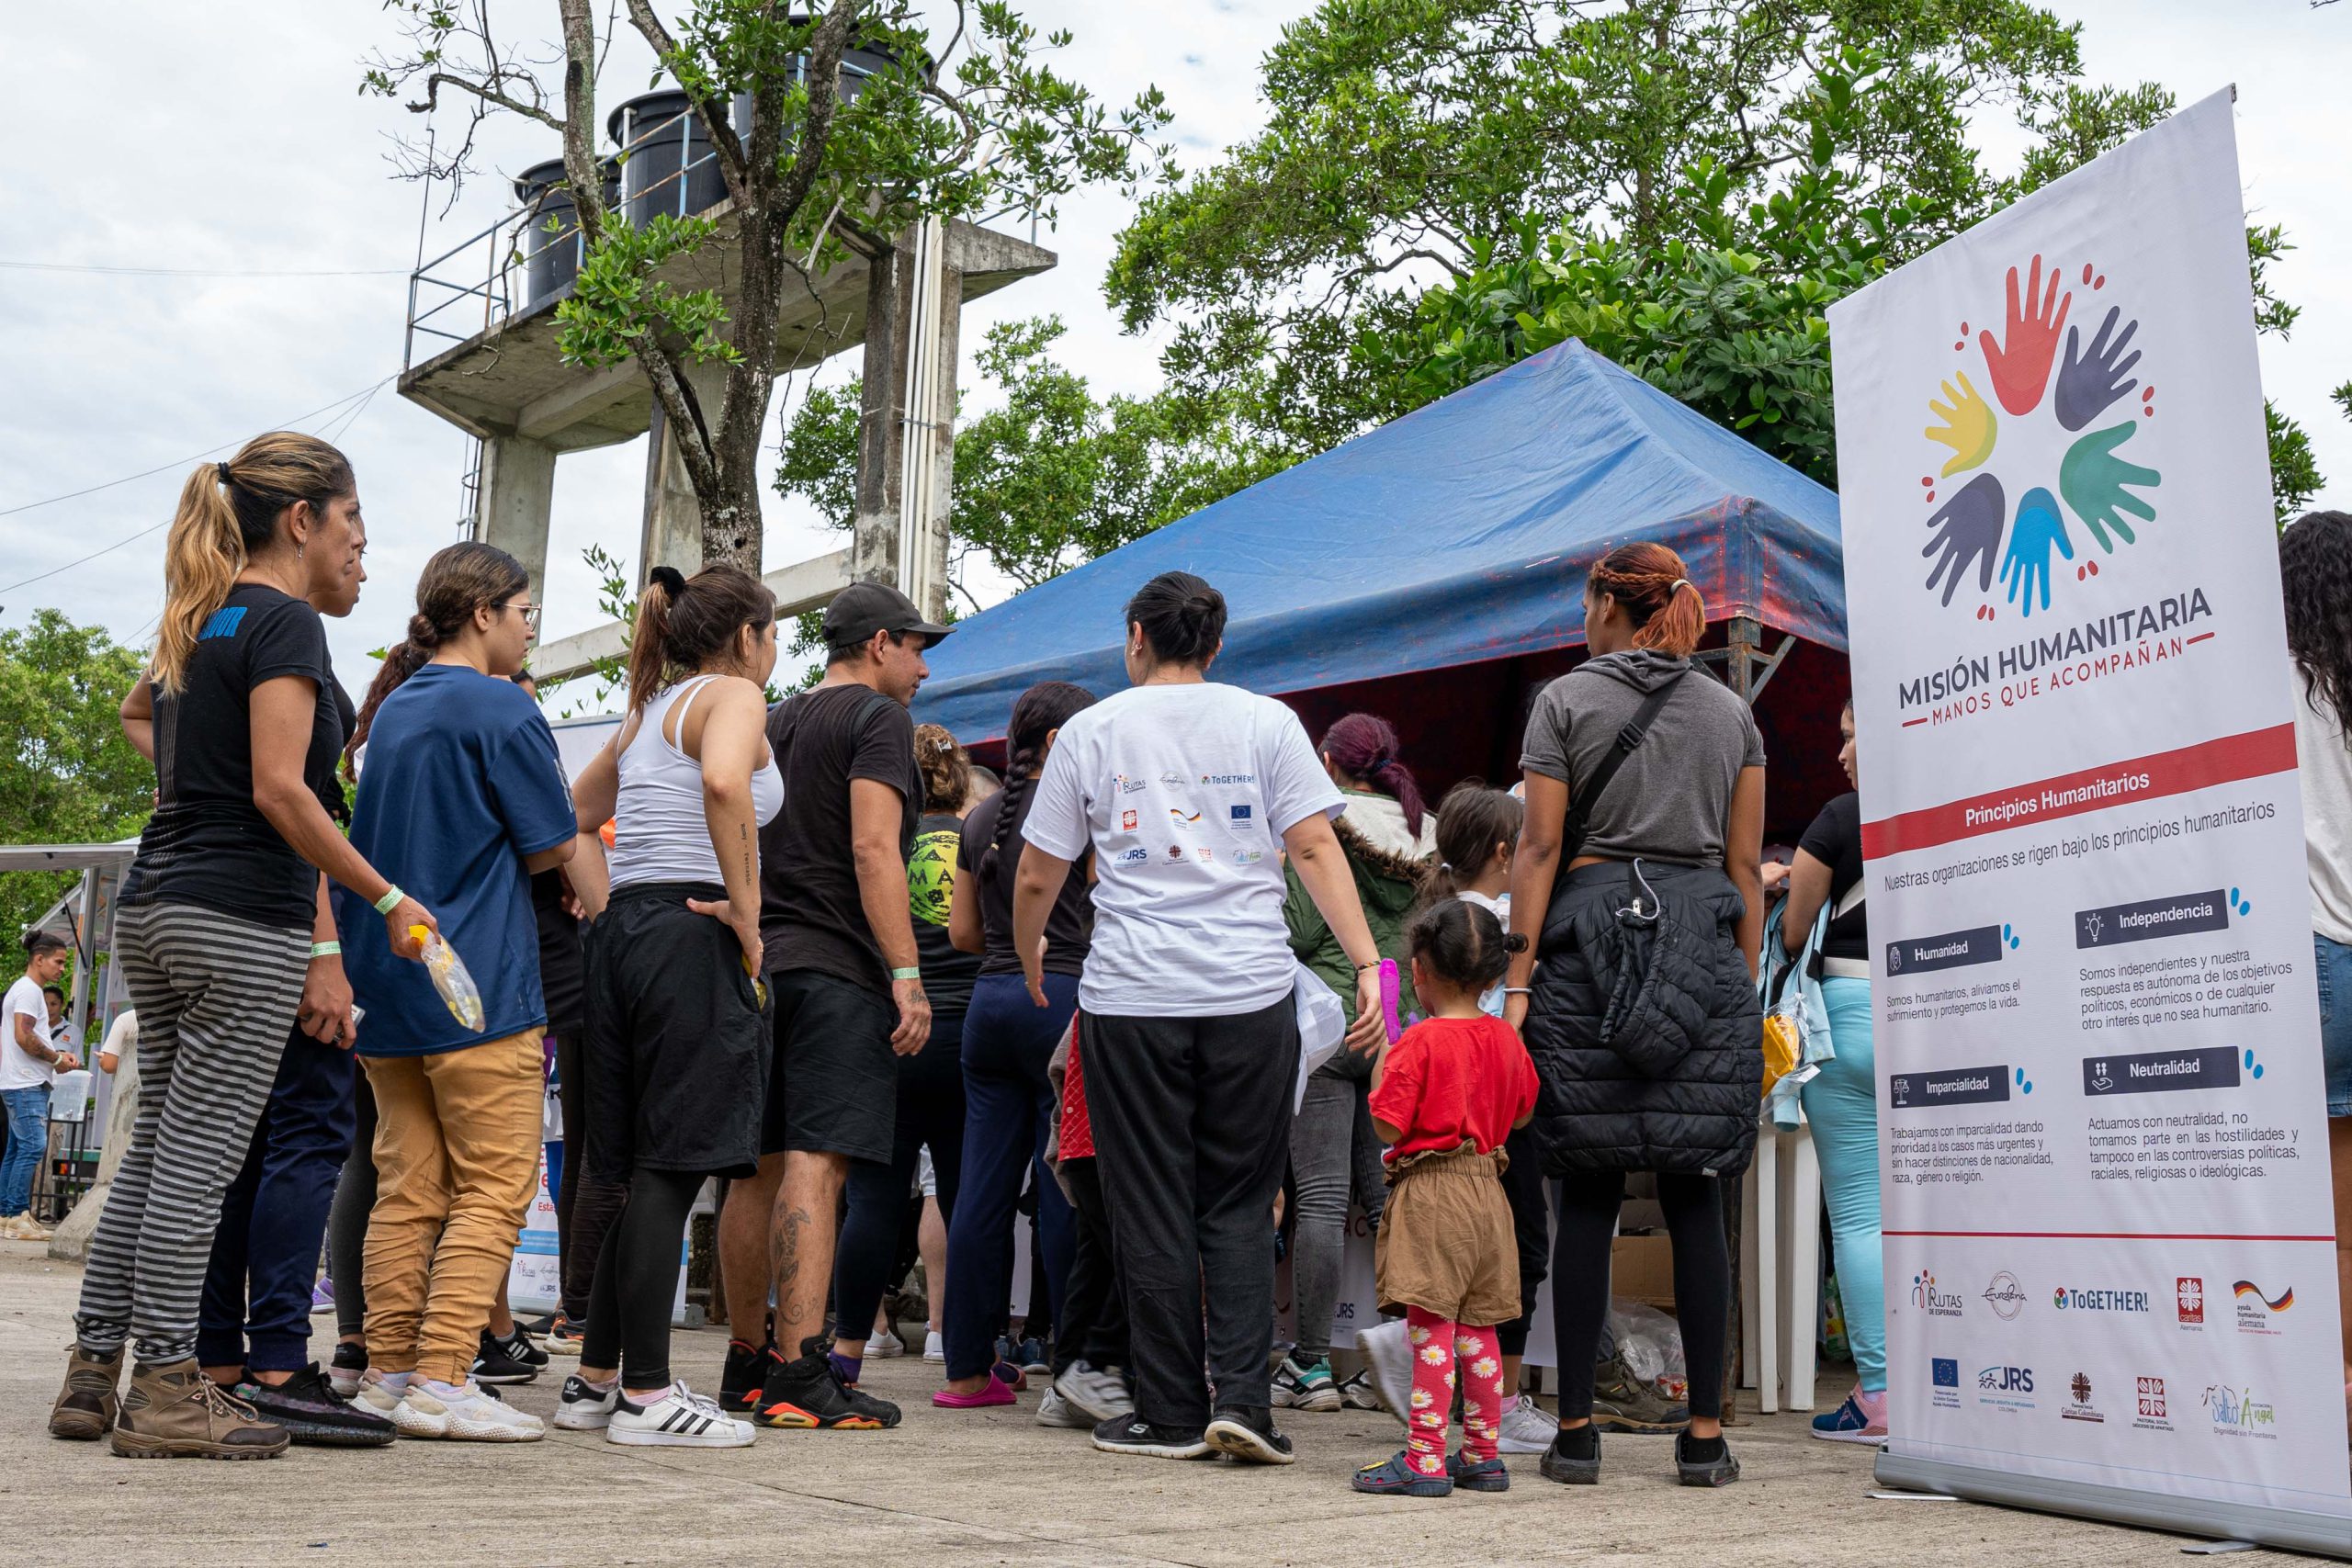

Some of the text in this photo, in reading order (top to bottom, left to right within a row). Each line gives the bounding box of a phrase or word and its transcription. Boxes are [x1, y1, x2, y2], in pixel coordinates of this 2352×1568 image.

[1898, 587, 2212, 709] MISIÓN HUMANITARIA
[1932, 636, 2183, 726] MANOS QUE ACOMPAÑAN
[1965, 772, 2150, 828] Principios Humanitarios
[1126, 849, 1147, 860] JRS
[1884, 801, 2276, 892] Nuestras organizaciones se rigen bajo los principios humanitarios
[2119, 902, 2213, 930] Independencia
[1914, 941, 1969, 962] Humanidad
[2079, 949, 2250, 982] Somos independientes y nuestra
[2080, 961, 2293, 998] respuesta es autónoma de los objetivos
[1886, 978, 2020, 1009] Somos humanitarios, aliviamos el
[2081, 981, 2276, 1017] políticos, económicos o de cualquier
[1886, 995, 2020, 1022] sufrimiento y protegemos la vida.
[2082, 999, 2272, 1031] otro interés que no sea humanitario.
[2129, 1058, 2200, 1078] Neutralidad
[1927, 1076, 1990, 1096] Imparcialidad
[1891, 1120, 2043, 1142] Trabajamos con imparcialidad dando
[2088, 1111, 2248, 1131] Actuamos con neutralidad, no
[1891, 1137, 2044, 1156] prioridad a los casos más urgentes y
[2088, 1126, 2299, 1148] tomamos parte en las hostilidades y
[1892, 1152, 2053, 1168] sin hacer distinciones de nacionalidad,
[2089, 1144, 2301, 1166] tampoco en las controversias políticas,
[1892, 1169, 1984, 1185] raza, género o religión.
[2091, 1163, 2267, 1182] raciales, religiosas o ideológicas.
[537, 1201, 556, 1212] Está
[1928, 1287, 1962, 1309] RUTAS
[2069, 1288, 2149, 1312] ToGETHER!
[1337, 1303, 1354, 1319] JRS
[1935, 1308, 1962, 1316] ESPERANZA
[2179, 1314, 2202, 1323] caritas
[2237, 1318, 2266, 1328] alemana
[1998, 1366, 2034, 1393] JRS
